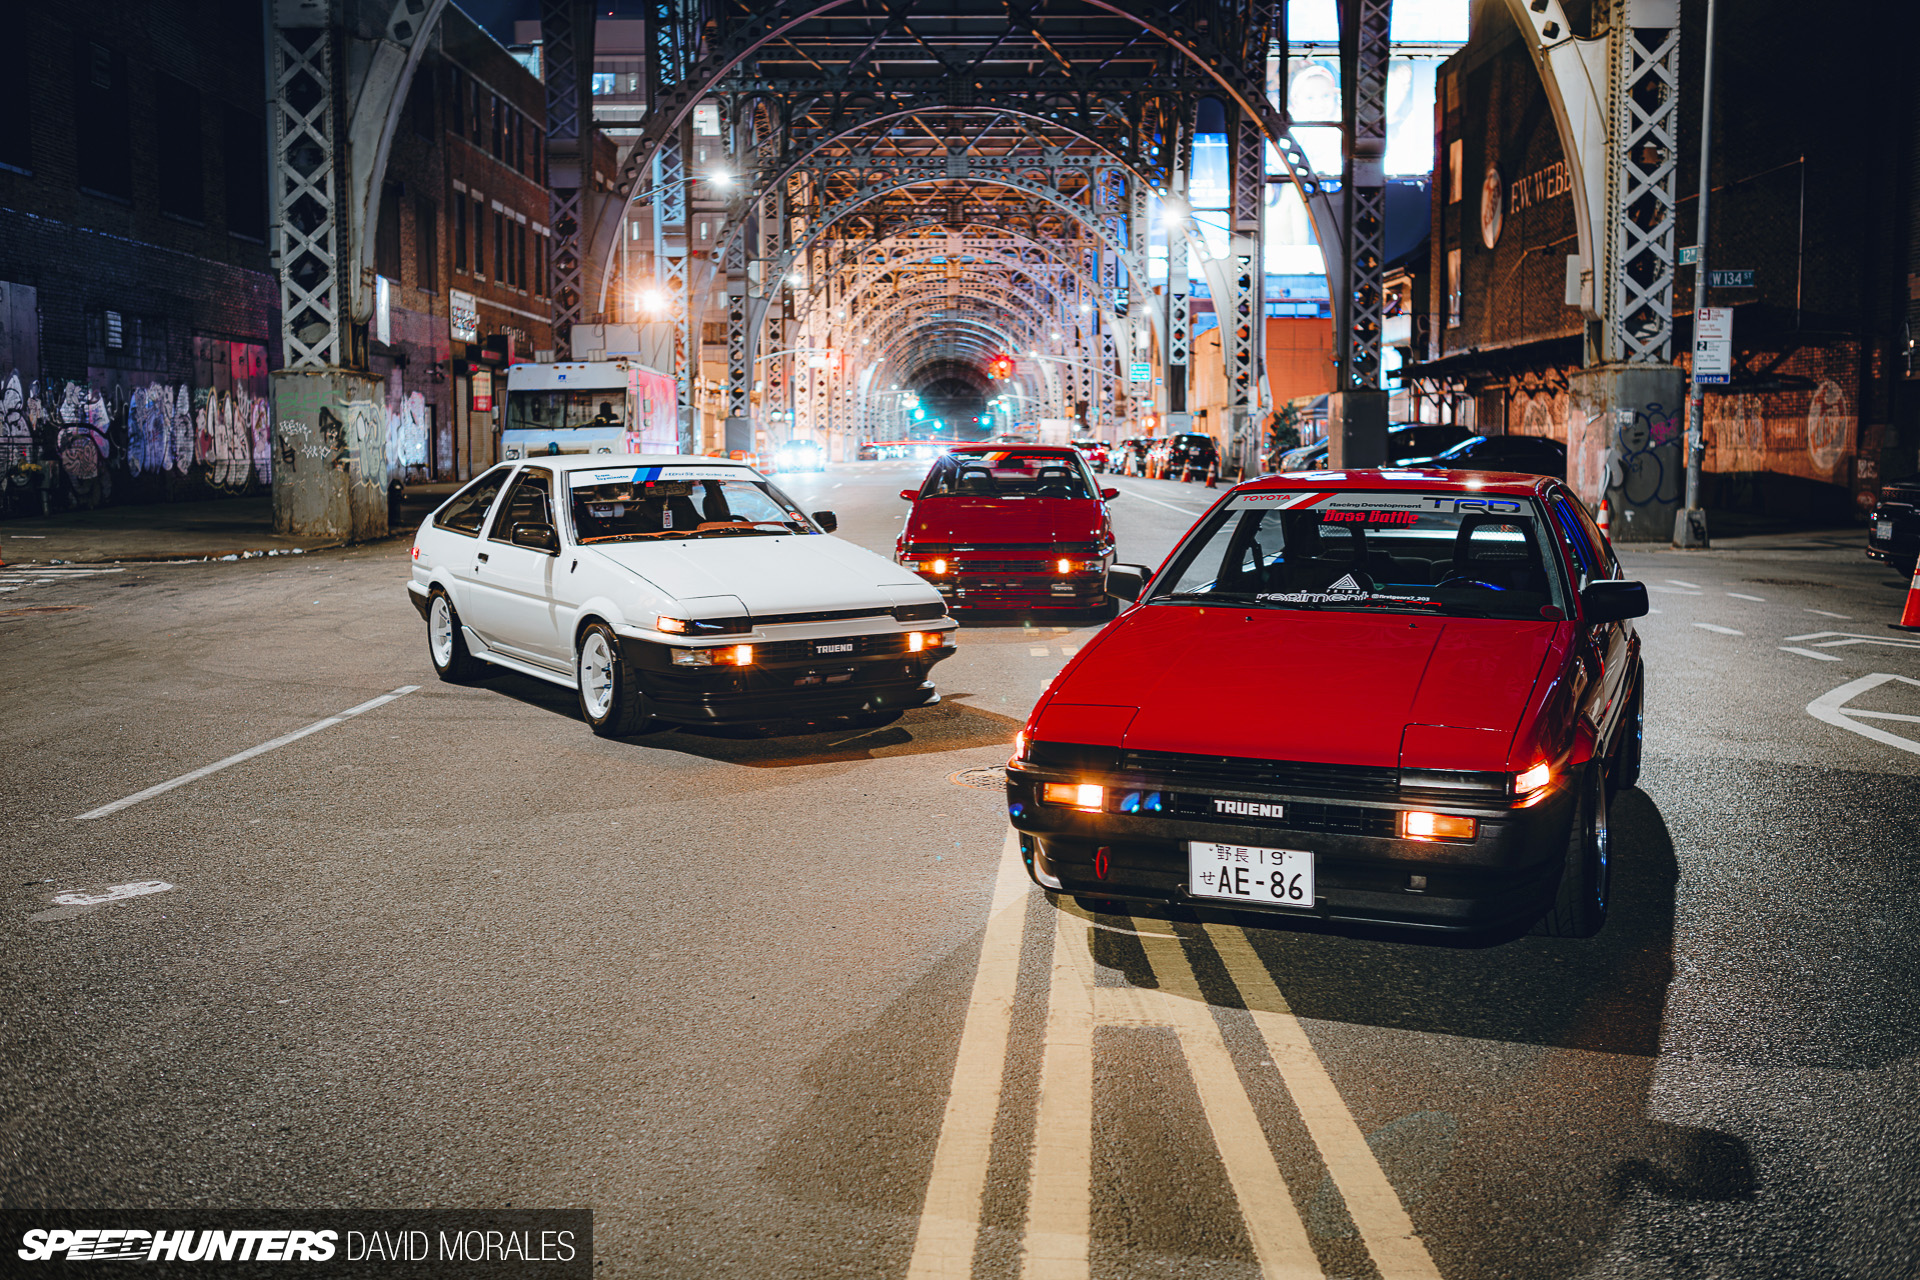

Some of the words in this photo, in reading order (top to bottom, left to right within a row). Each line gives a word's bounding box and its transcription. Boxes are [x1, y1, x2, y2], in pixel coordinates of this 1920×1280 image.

[1712, 273, 1722, 285] W
[1723, 272, 1743, 285] 134
[1242, 494, 1291, 502] TOYOTA
[1422, 496, 1522, 515] TRD
[1323, 510, 1366, 523] Boss
[1368, 510, 1420, 525] Battle
[815, 643, 854, 654] TRUENO
[1214, 799, 1284, 818] TRUENO
[1199, 871, 1216, 885] せ
[1217, 865, 1304, 900] AE-86
